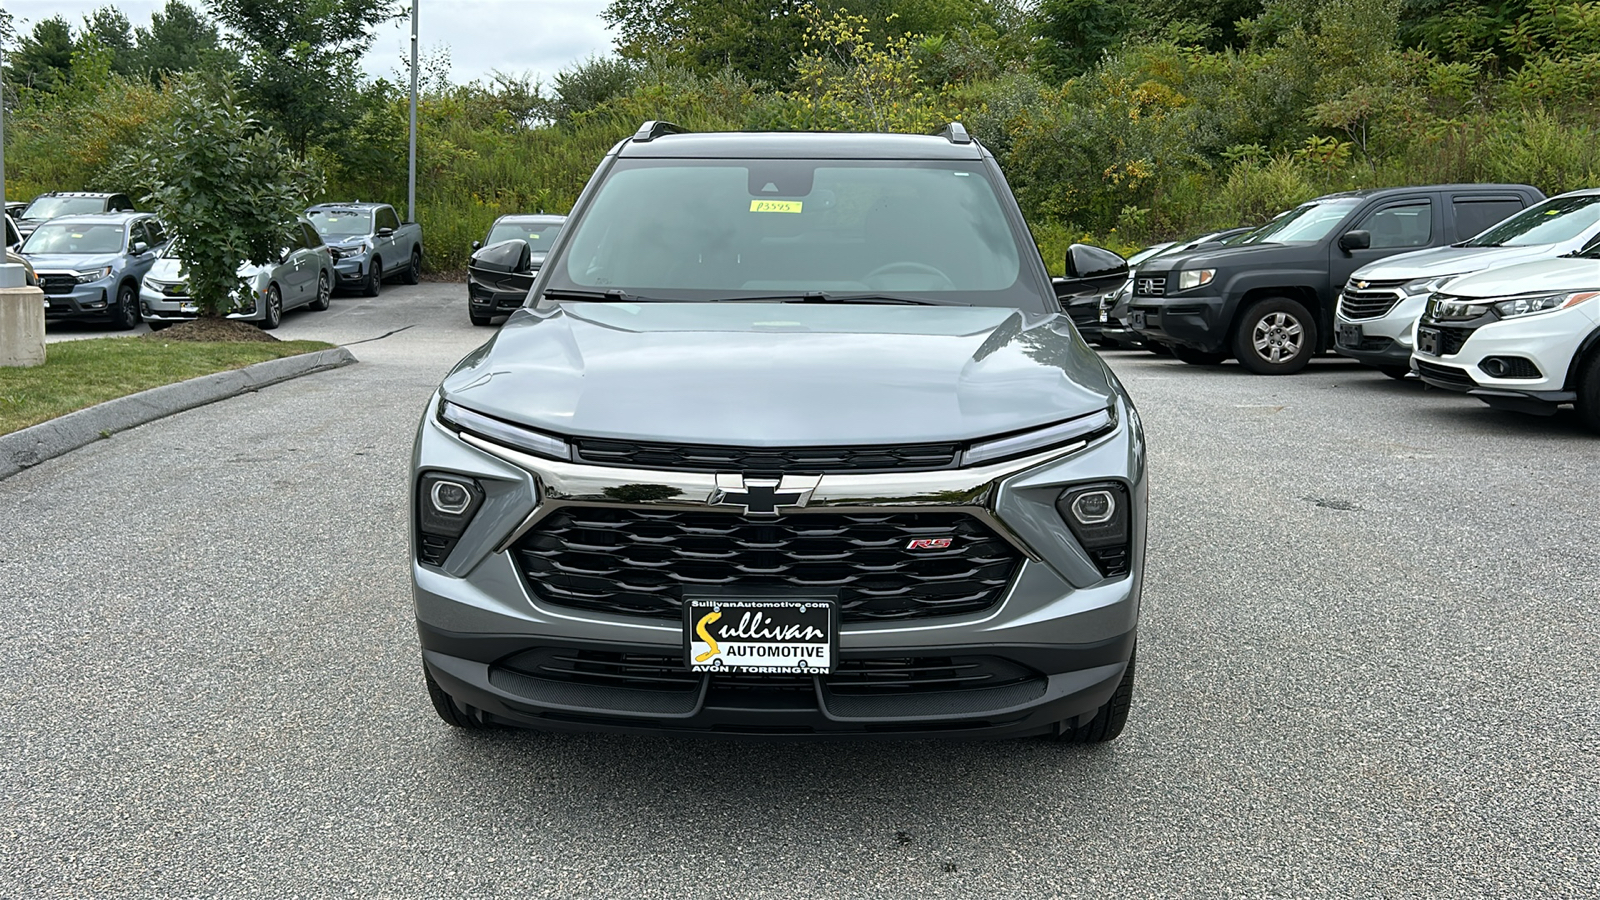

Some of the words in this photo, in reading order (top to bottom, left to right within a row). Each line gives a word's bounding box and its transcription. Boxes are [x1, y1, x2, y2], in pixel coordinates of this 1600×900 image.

[906, 538, 953, 549] RS
[695, 611, 824, 662] Sullivan
[726, 645, 824, 657] AUTOMOTIVE
[691, 665, 729, 673] AVON
[740, 666, 830, 674] TORRINGTON
